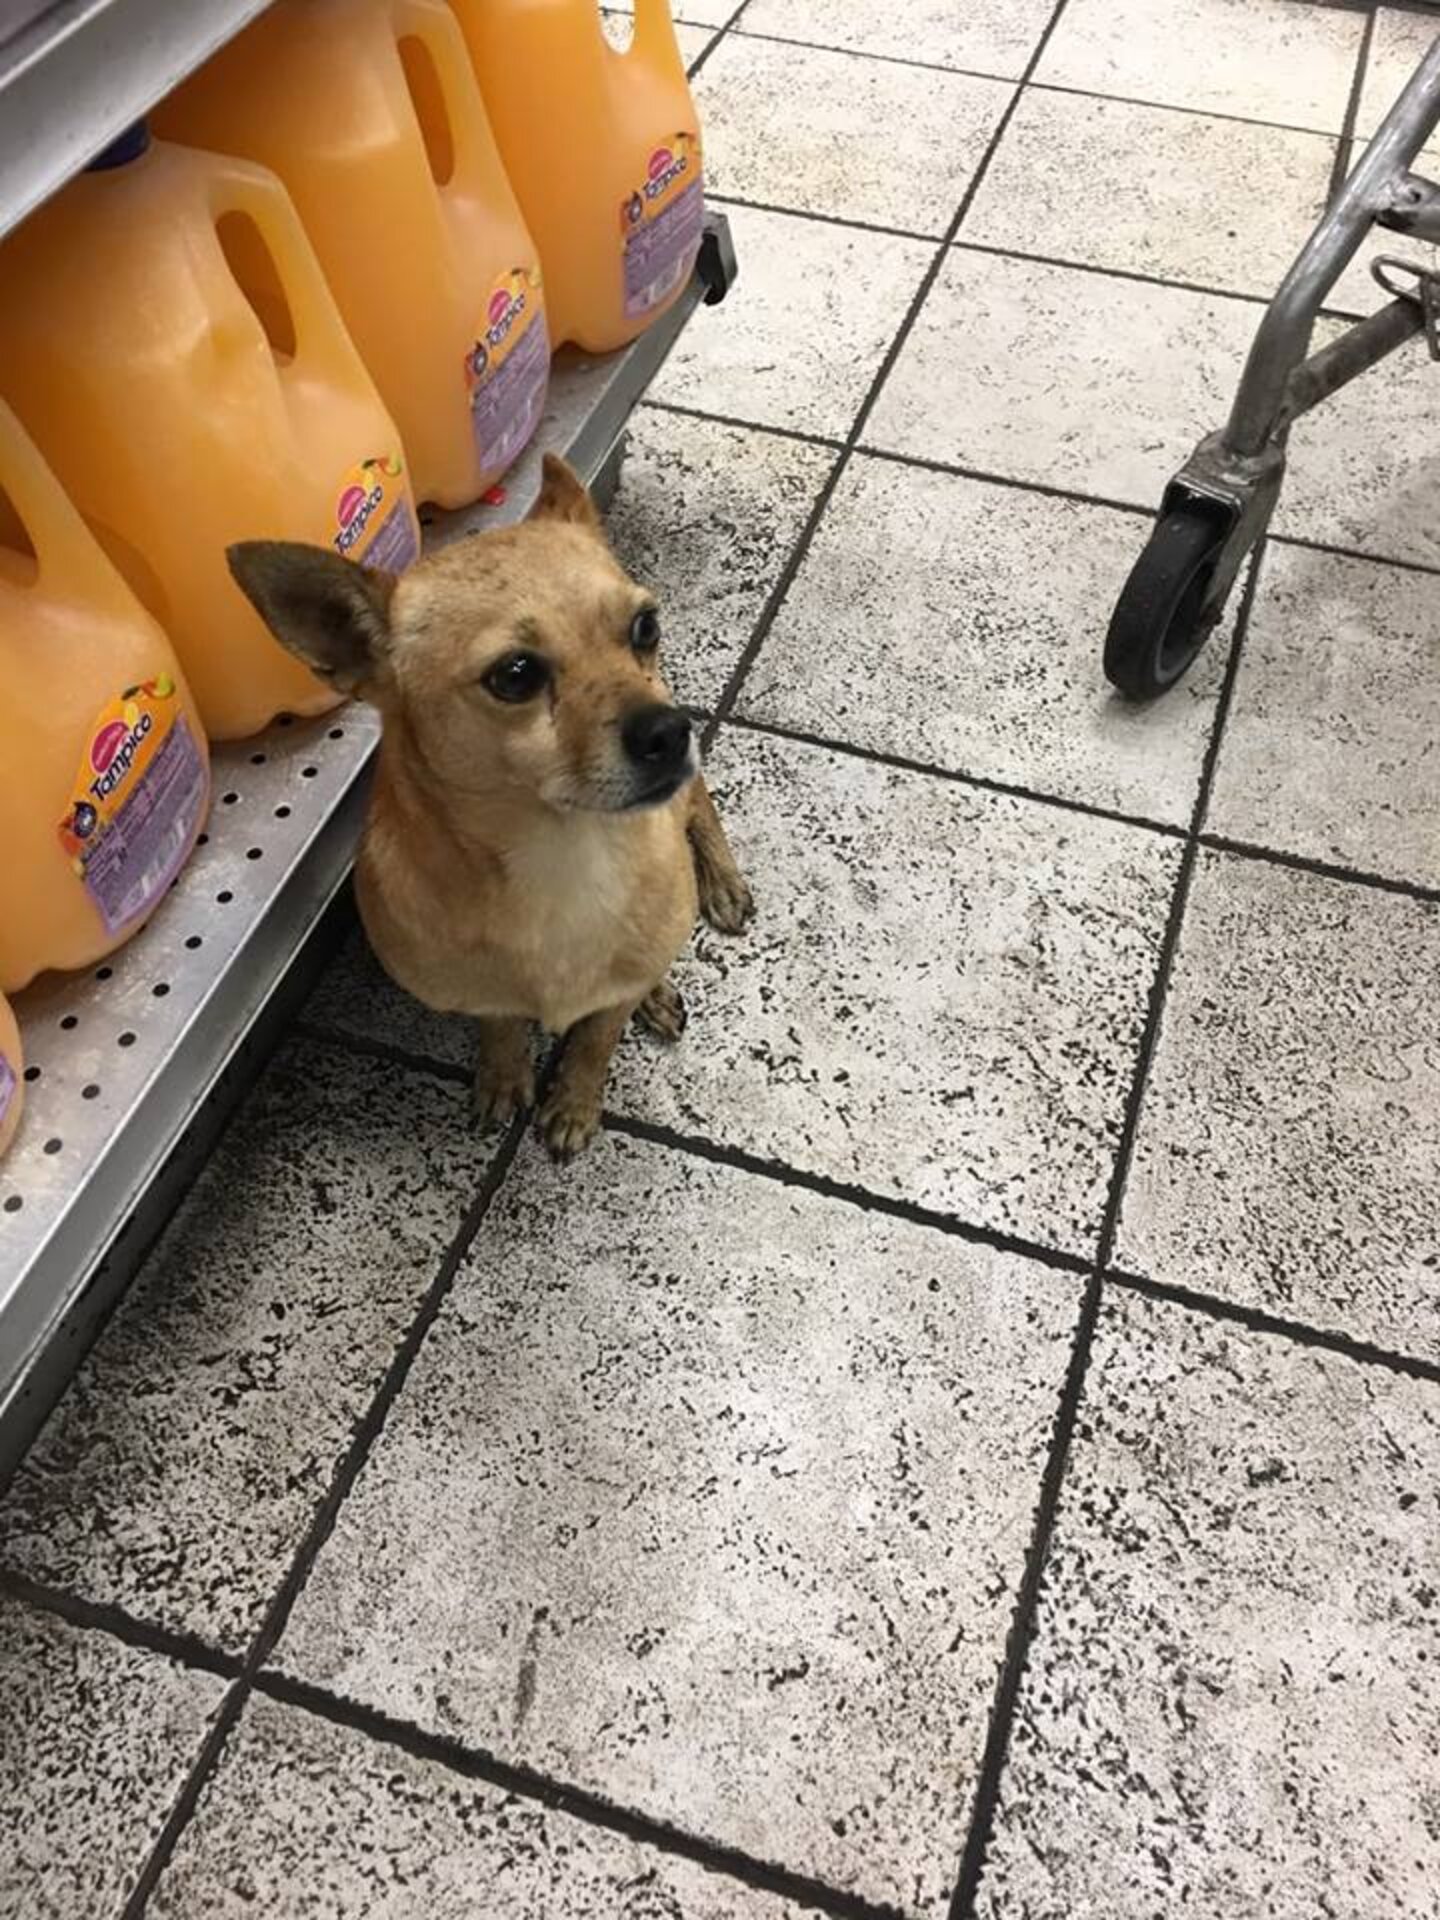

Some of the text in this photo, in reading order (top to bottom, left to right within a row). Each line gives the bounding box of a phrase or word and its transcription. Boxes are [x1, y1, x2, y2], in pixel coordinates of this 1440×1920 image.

[642, 156, 687, 199] Tampico
[486, 293, 525, 348] Tampico
[334, 485, 383, 555] Tampico
[90, 714, 152, 801] Tampico
